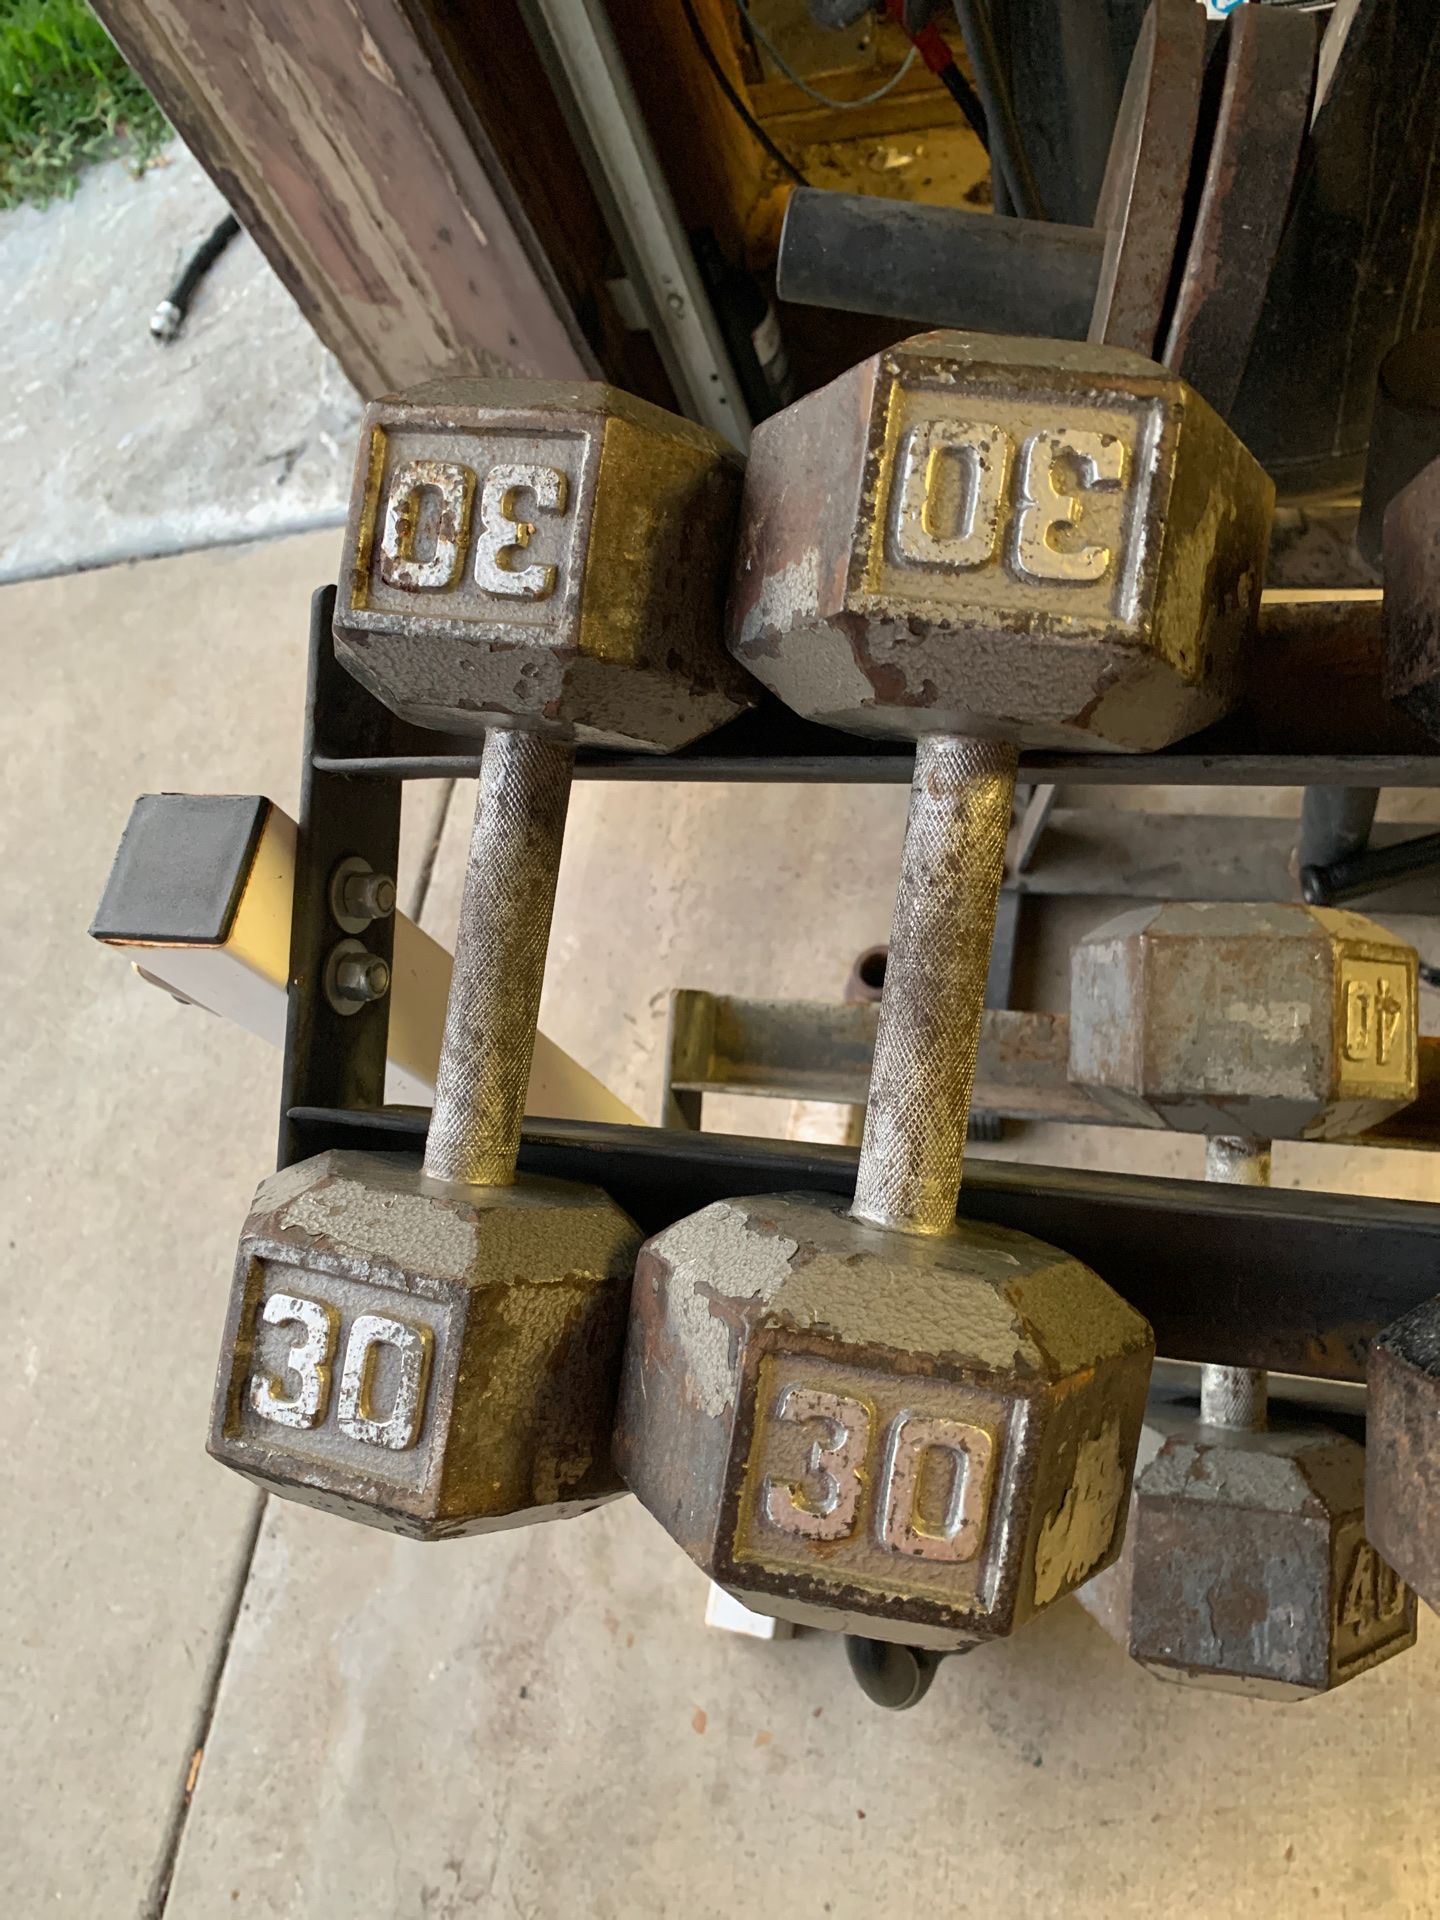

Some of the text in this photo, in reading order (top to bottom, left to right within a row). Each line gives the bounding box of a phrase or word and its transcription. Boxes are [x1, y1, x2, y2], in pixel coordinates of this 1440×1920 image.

[381, 459, 567, 600] 30
[895, 419, 1127, 584] 30
[251, 1293, 433, 1450] 30
[765, 1382, 993, 1564] 30
